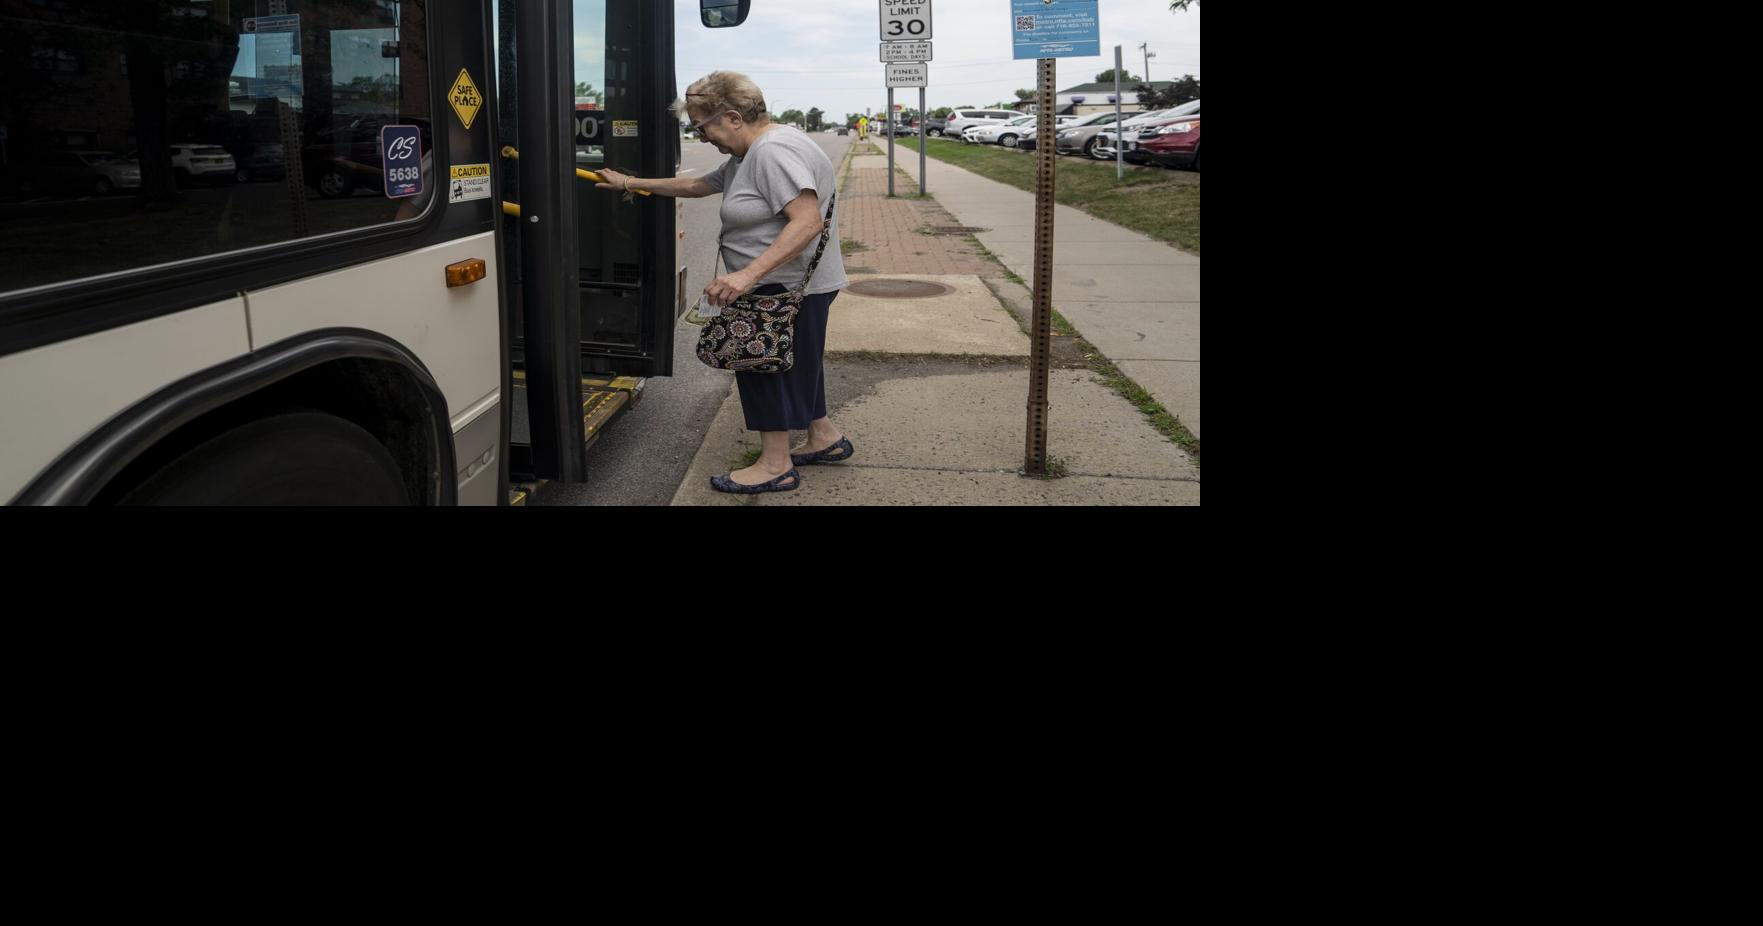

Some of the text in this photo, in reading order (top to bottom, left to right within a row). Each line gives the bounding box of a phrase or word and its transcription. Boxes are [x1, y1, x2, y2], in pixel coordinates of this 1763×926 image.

[890, 7, 921, 16] LIMIT
[887, 19, 925, 35] 30
[457, 85, 473, 95] SAFE
[388, 136, 417, 160] CS
[389, 167, 419, 182] 5638
[458, 167, 487, 177] CAUTION
[478, 177, 489, 185] CLEAR
